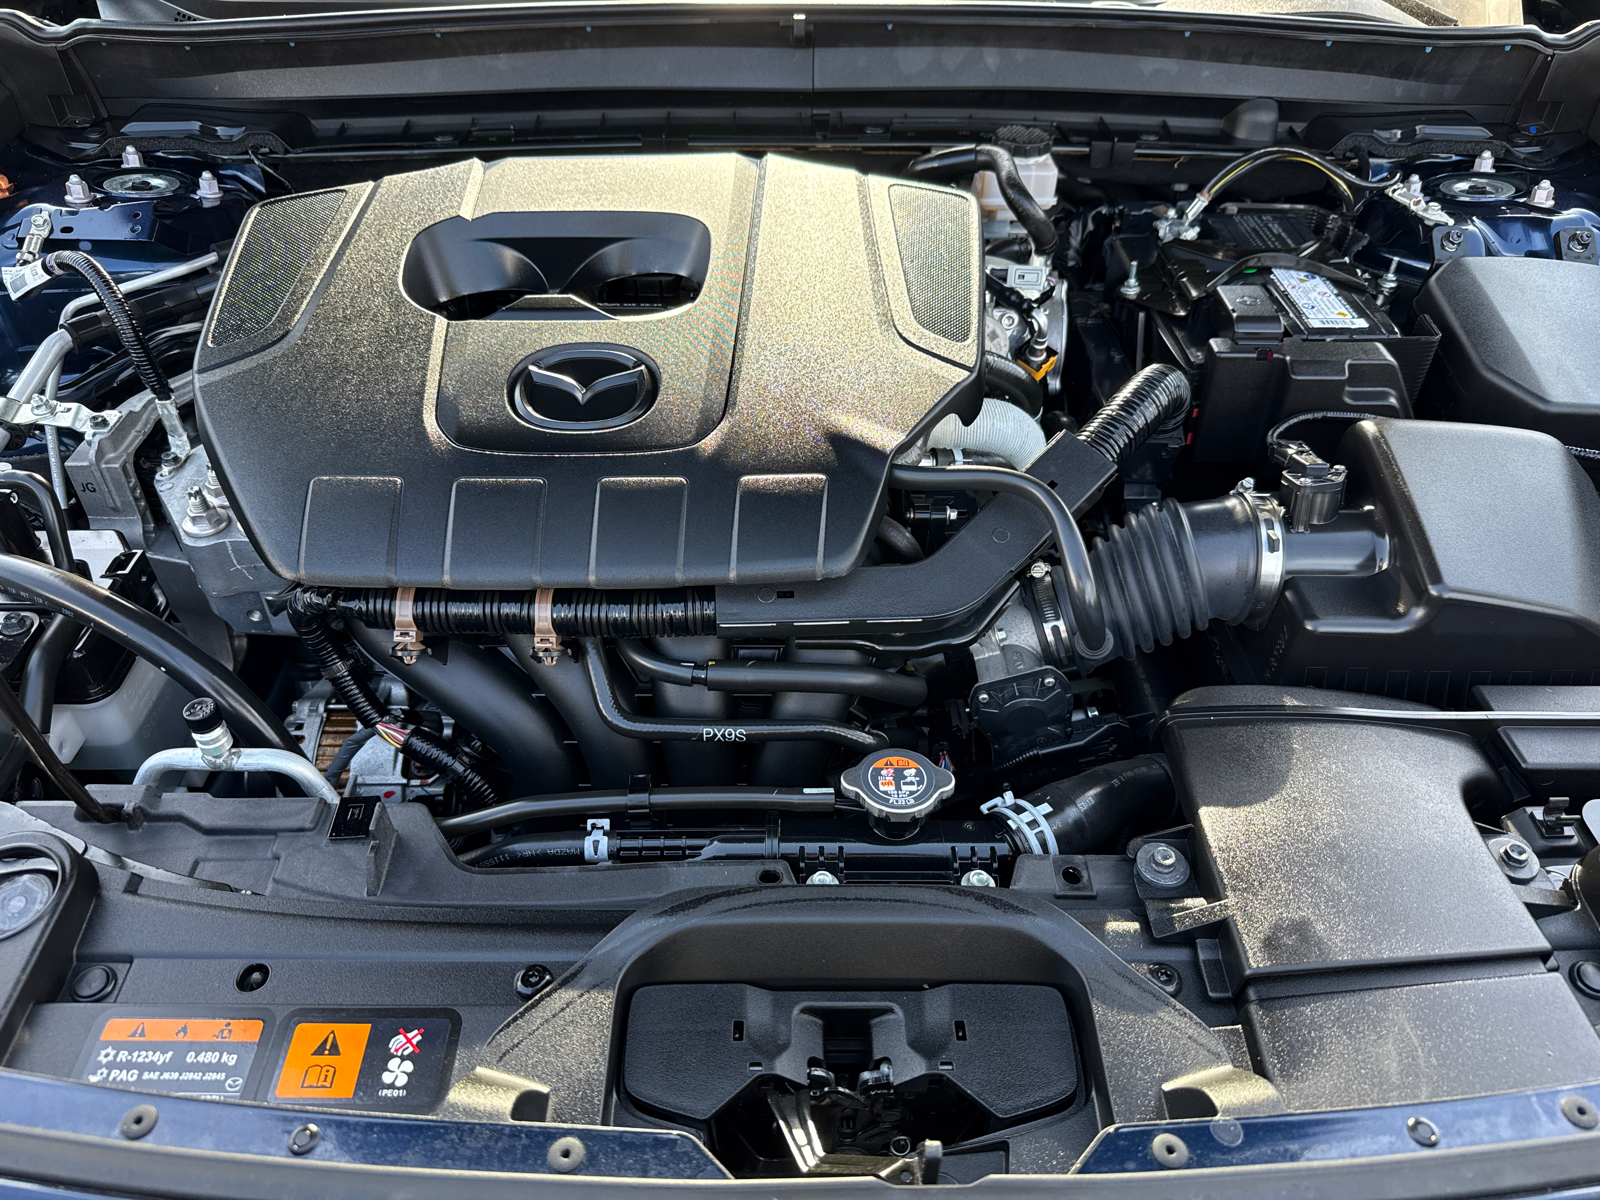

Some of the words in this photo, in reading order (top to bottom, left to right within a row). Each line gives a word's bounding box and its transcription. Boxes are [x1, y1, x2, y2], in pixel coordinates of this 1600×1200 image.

[80, 481, 97, 493] JG
[703, 728, 747, 742] PX9S
[547, 848, 580, 856] MAZDA
[116, 1050, 174, 1066] R-1234yf
[185, 1051, 220, 1064] 0.480
[220, 1051, 238, 1066] kg
[108, 1069, 139, 1082] PAG
[141, 1071, 160, 1081] SAE
[378, 1089, 407, 1098] (PE01)
